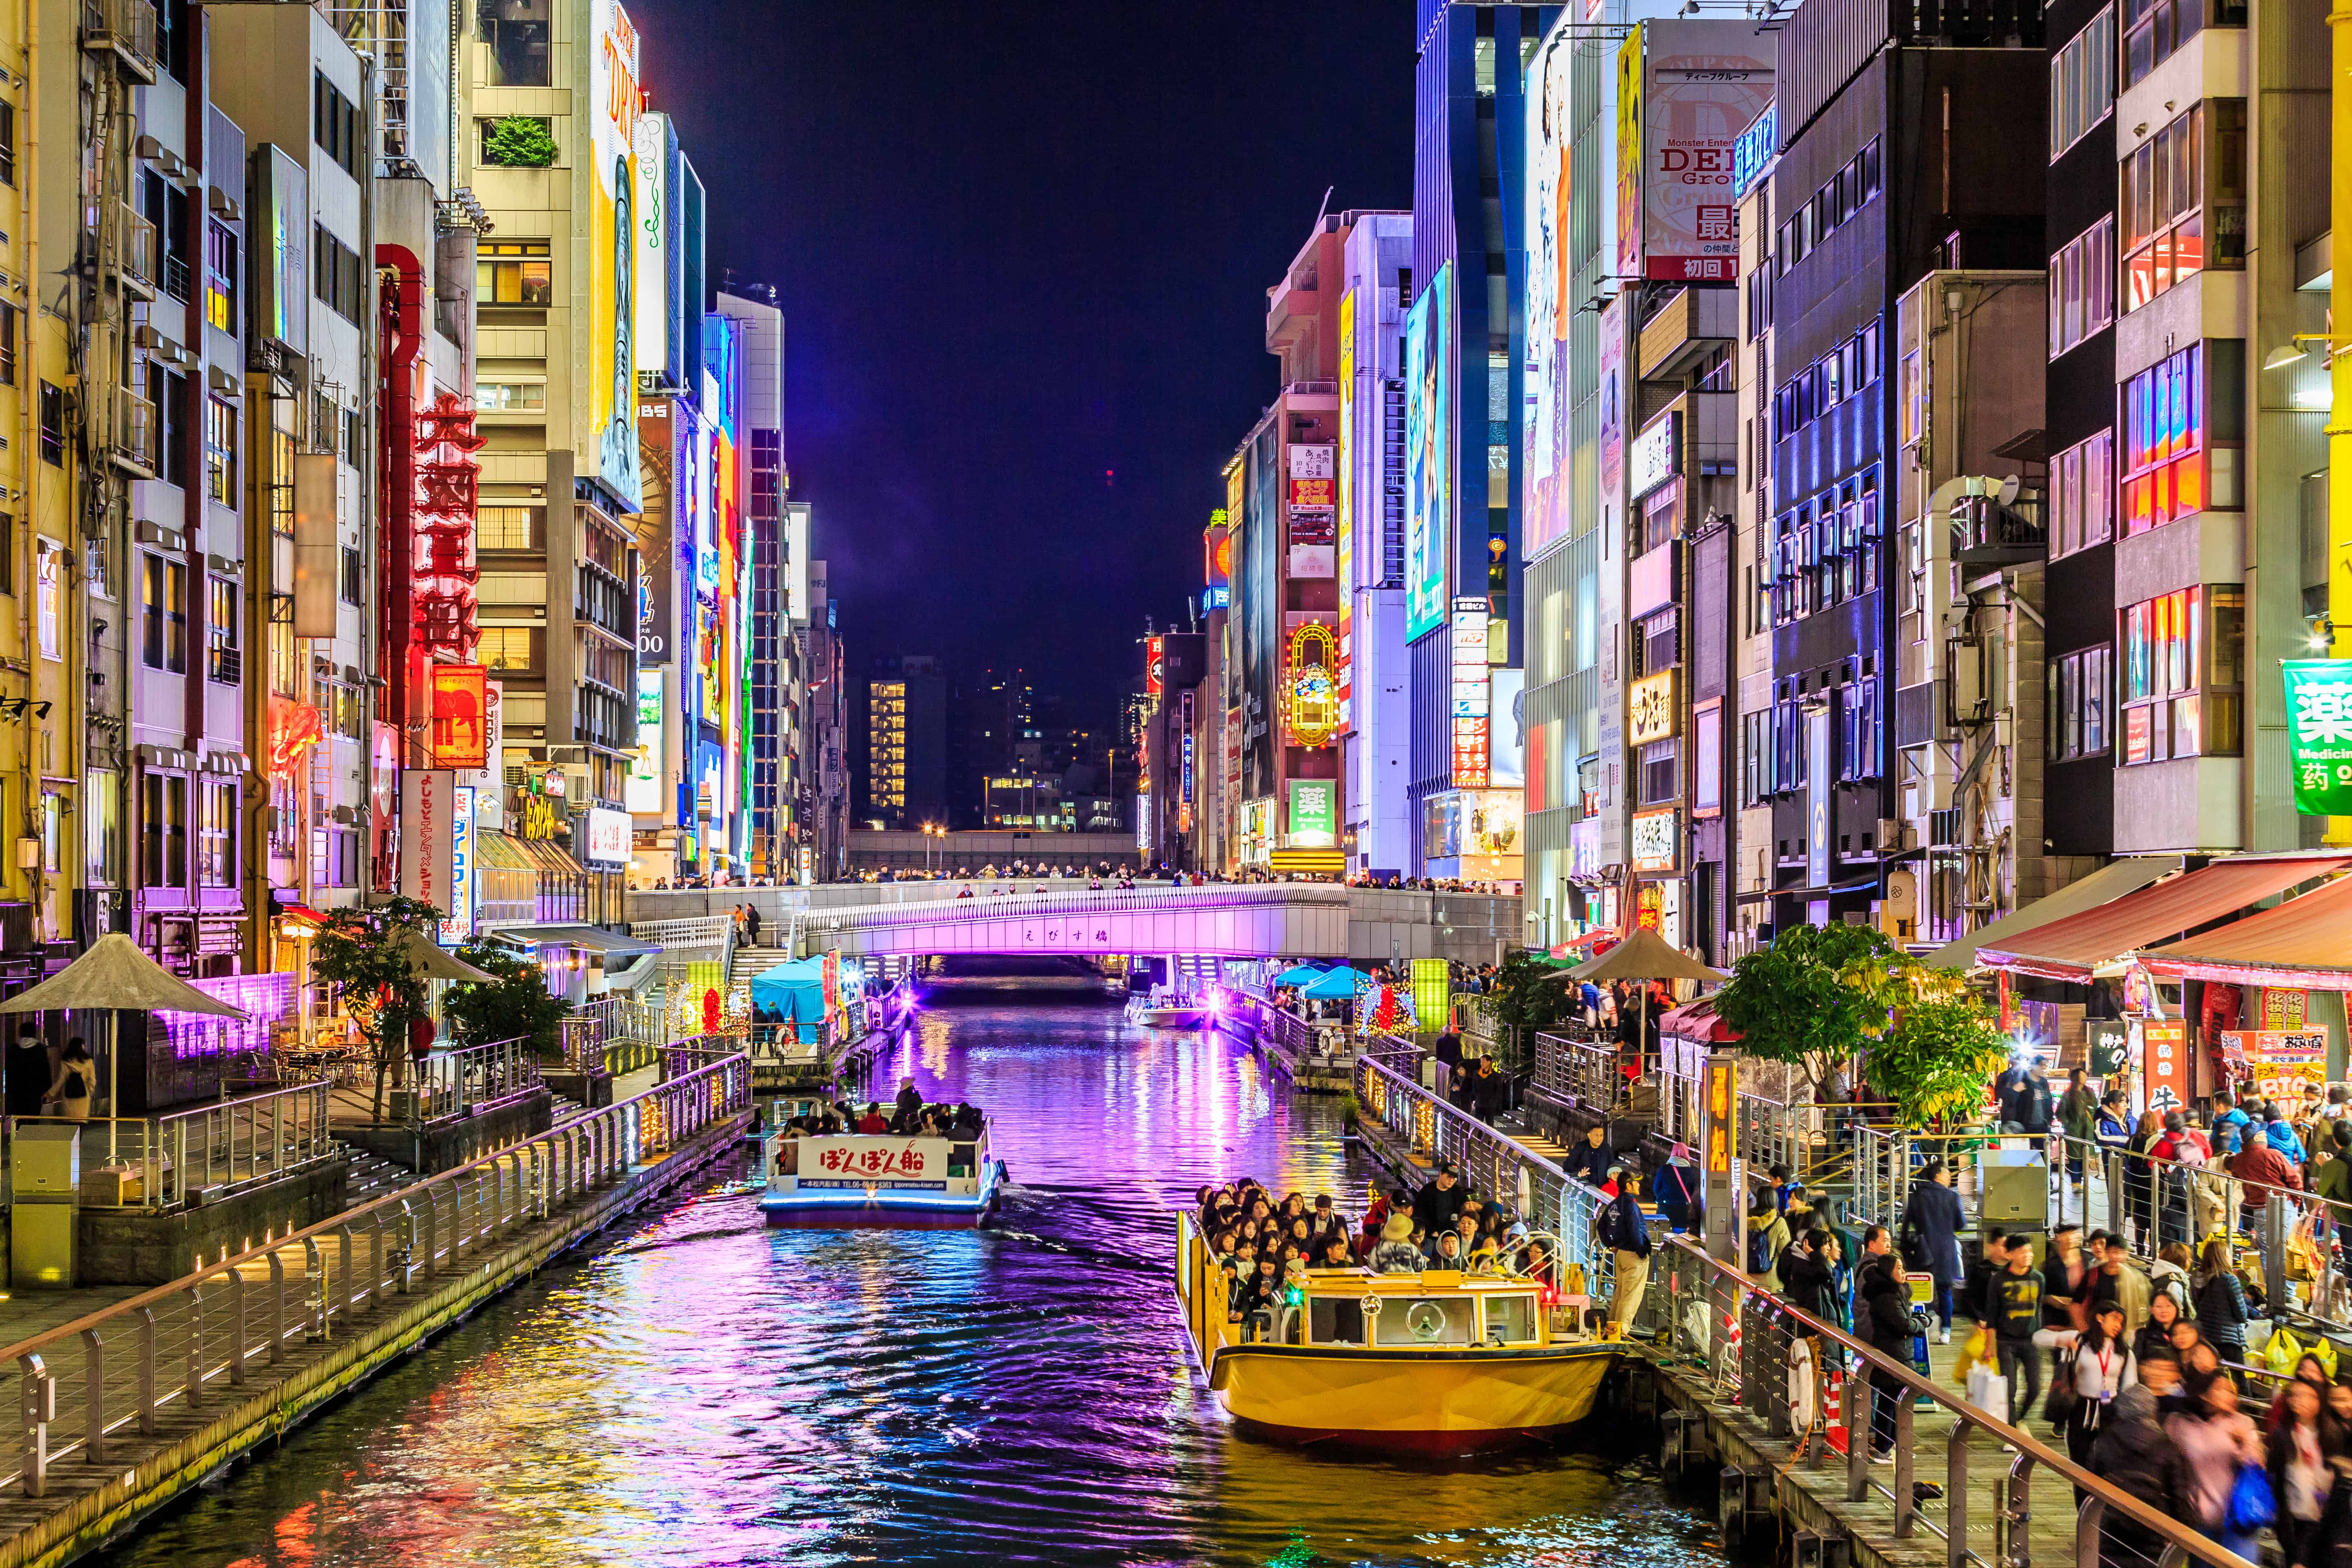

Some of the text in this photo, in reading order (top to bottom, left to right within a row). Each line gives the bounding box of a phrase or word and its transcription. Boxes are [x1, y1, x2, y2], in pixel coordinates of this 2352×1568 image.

[616, 5, 633, 61] SUPER
[1668, 139, 1705, 147] Monster
[1684, 259, 1722, 278] 初回
[1322, 449, 1330, 464] 焼肉
[1212, 508, 1229, 526] 美
[2294, 681, 2352, 744] 薬
[1474, 717, 1487, 779] インターネット
[2298, 748, 2352, 760] Medicin
[1459, 744, 1472, 779] コミック
[2300, 762, 2329, 791] 药
[1298, 786, 1326, 815] 薬
[441, 921, 470, 933] 免税
[1025, 929, 1107, 942] えびす橋
[820, 1147, 924, 1177] ぽんぽん船
